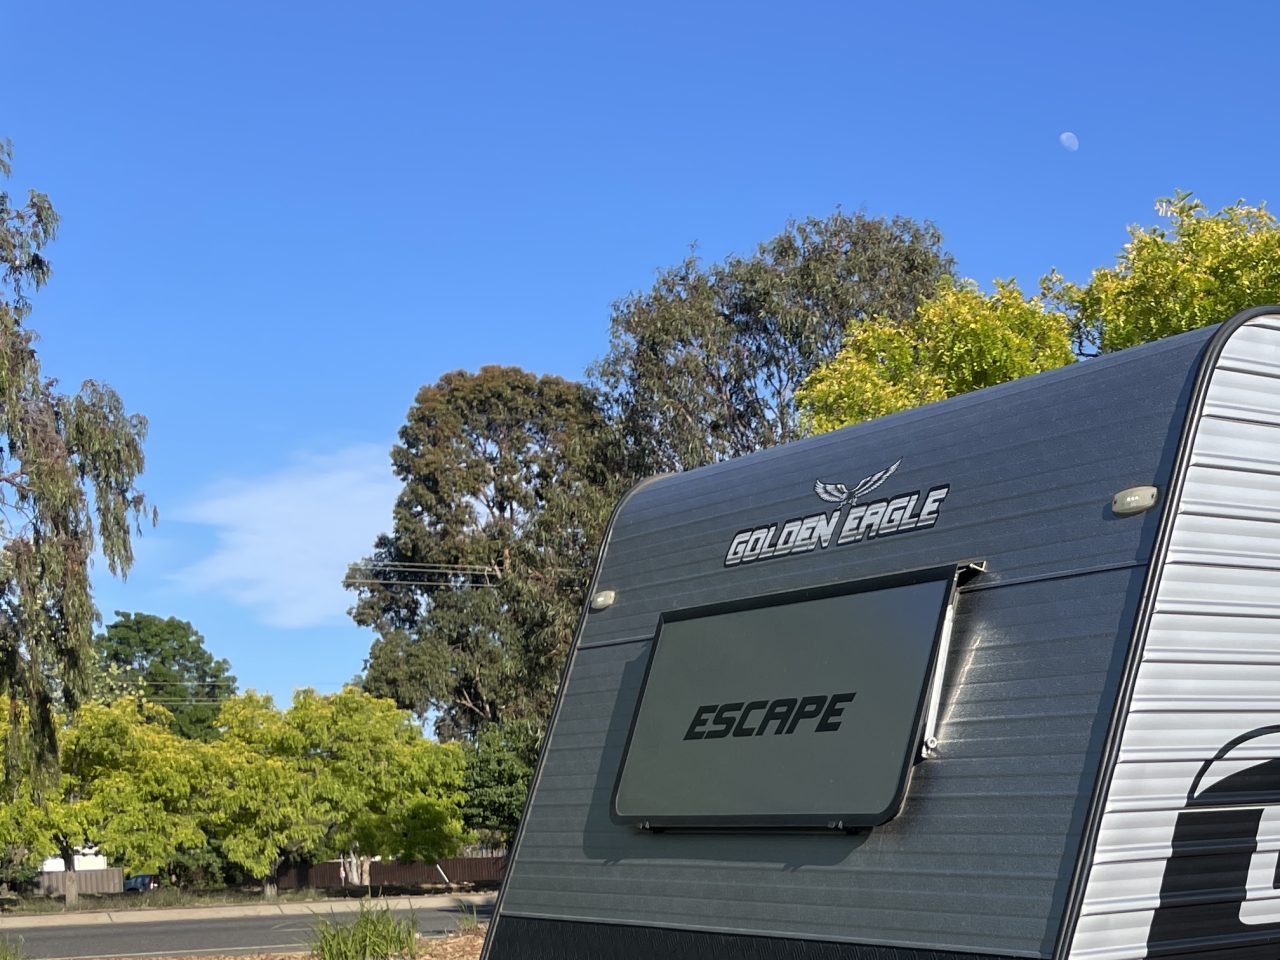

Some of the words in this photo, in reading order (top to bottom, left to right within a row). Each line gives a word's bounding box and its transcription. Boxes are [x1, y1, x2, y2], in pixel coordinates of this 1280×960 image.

[724, 508, 841, 567] GOLDEN
[837, 485, 950, 546] EAGLE
[683, 692, 857, 740] ESCAPE
